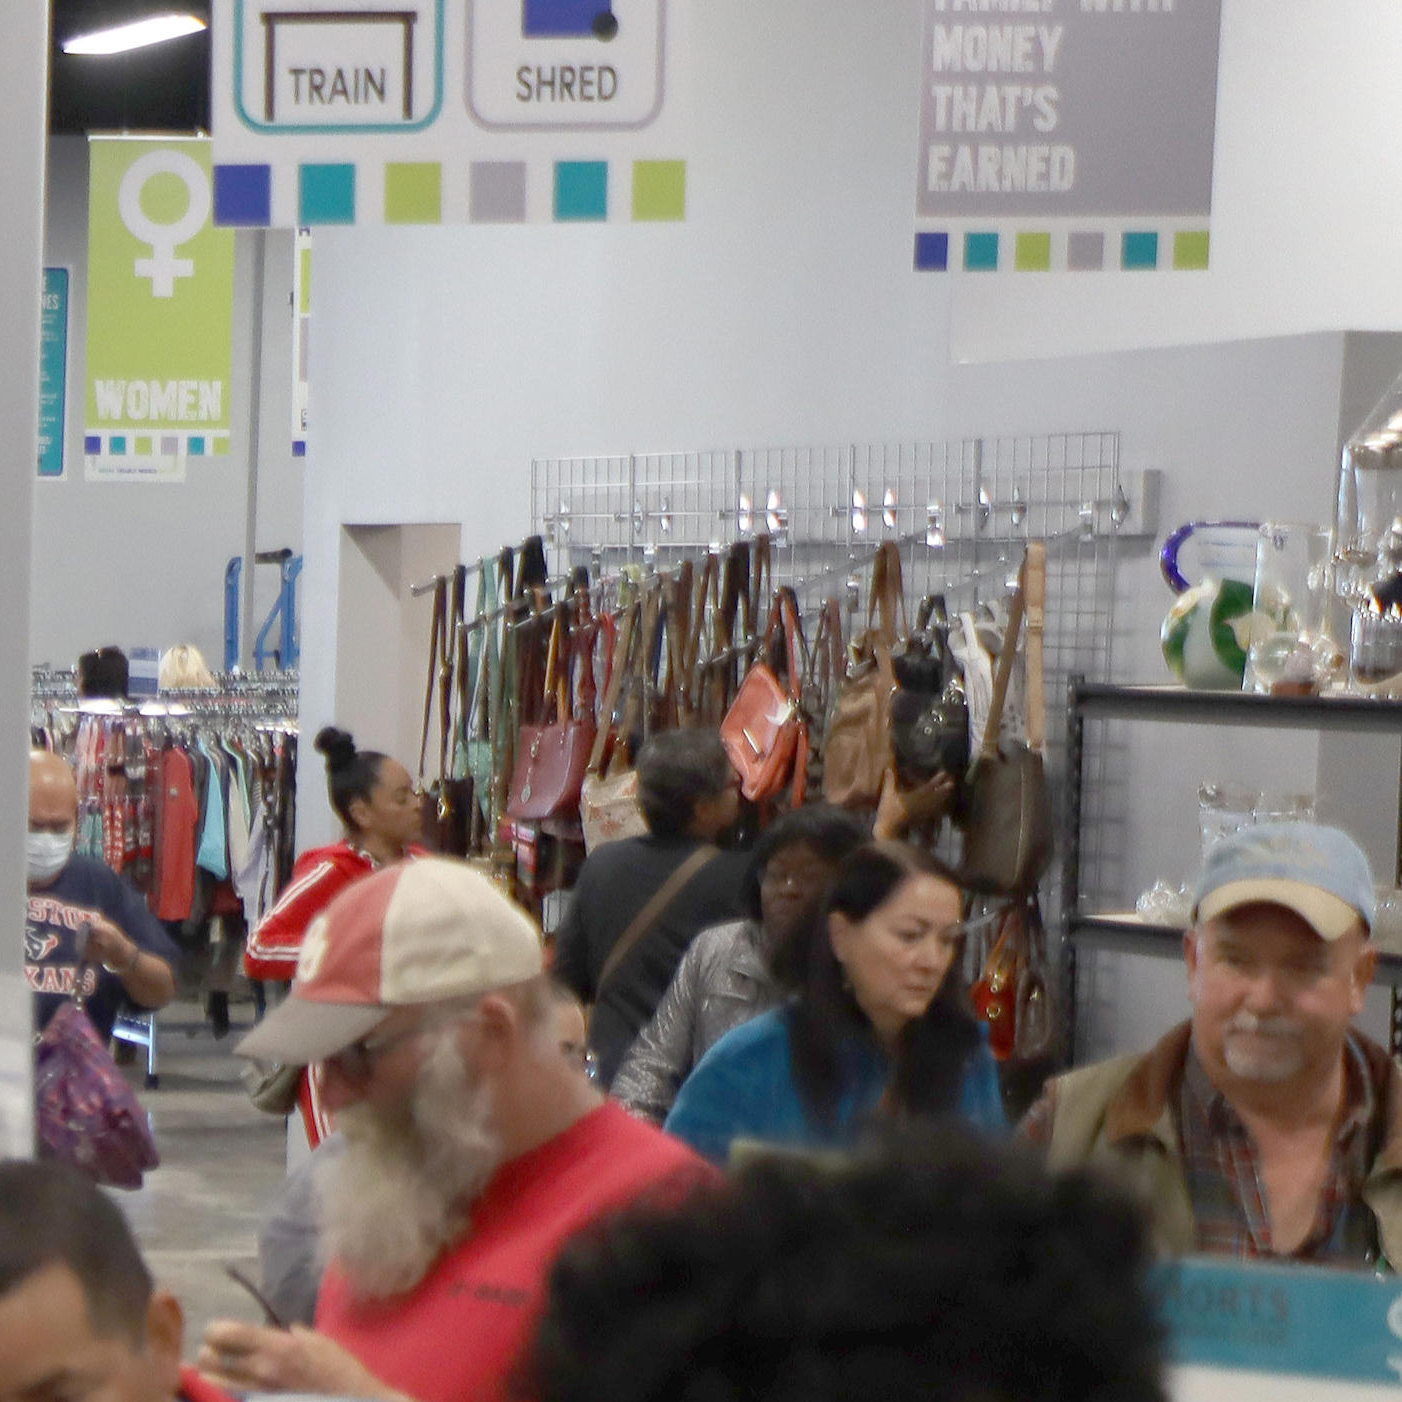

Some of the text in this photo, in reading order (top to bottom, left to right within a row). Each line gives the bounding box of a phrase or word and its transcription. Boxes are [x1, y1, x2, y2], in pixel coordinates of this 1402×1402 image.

[931, 25, 1065, 73] MONEY
[288, 66, 387, 104] TRAIN
[515, 65, 618, 102] SHRED
[931, 84, 1061, 133] THAT'S
[927, 145, 1077, 192] EARNED
[94, 379, 222, 422] WOMEN
[23, 965, 96, 997] XANS
